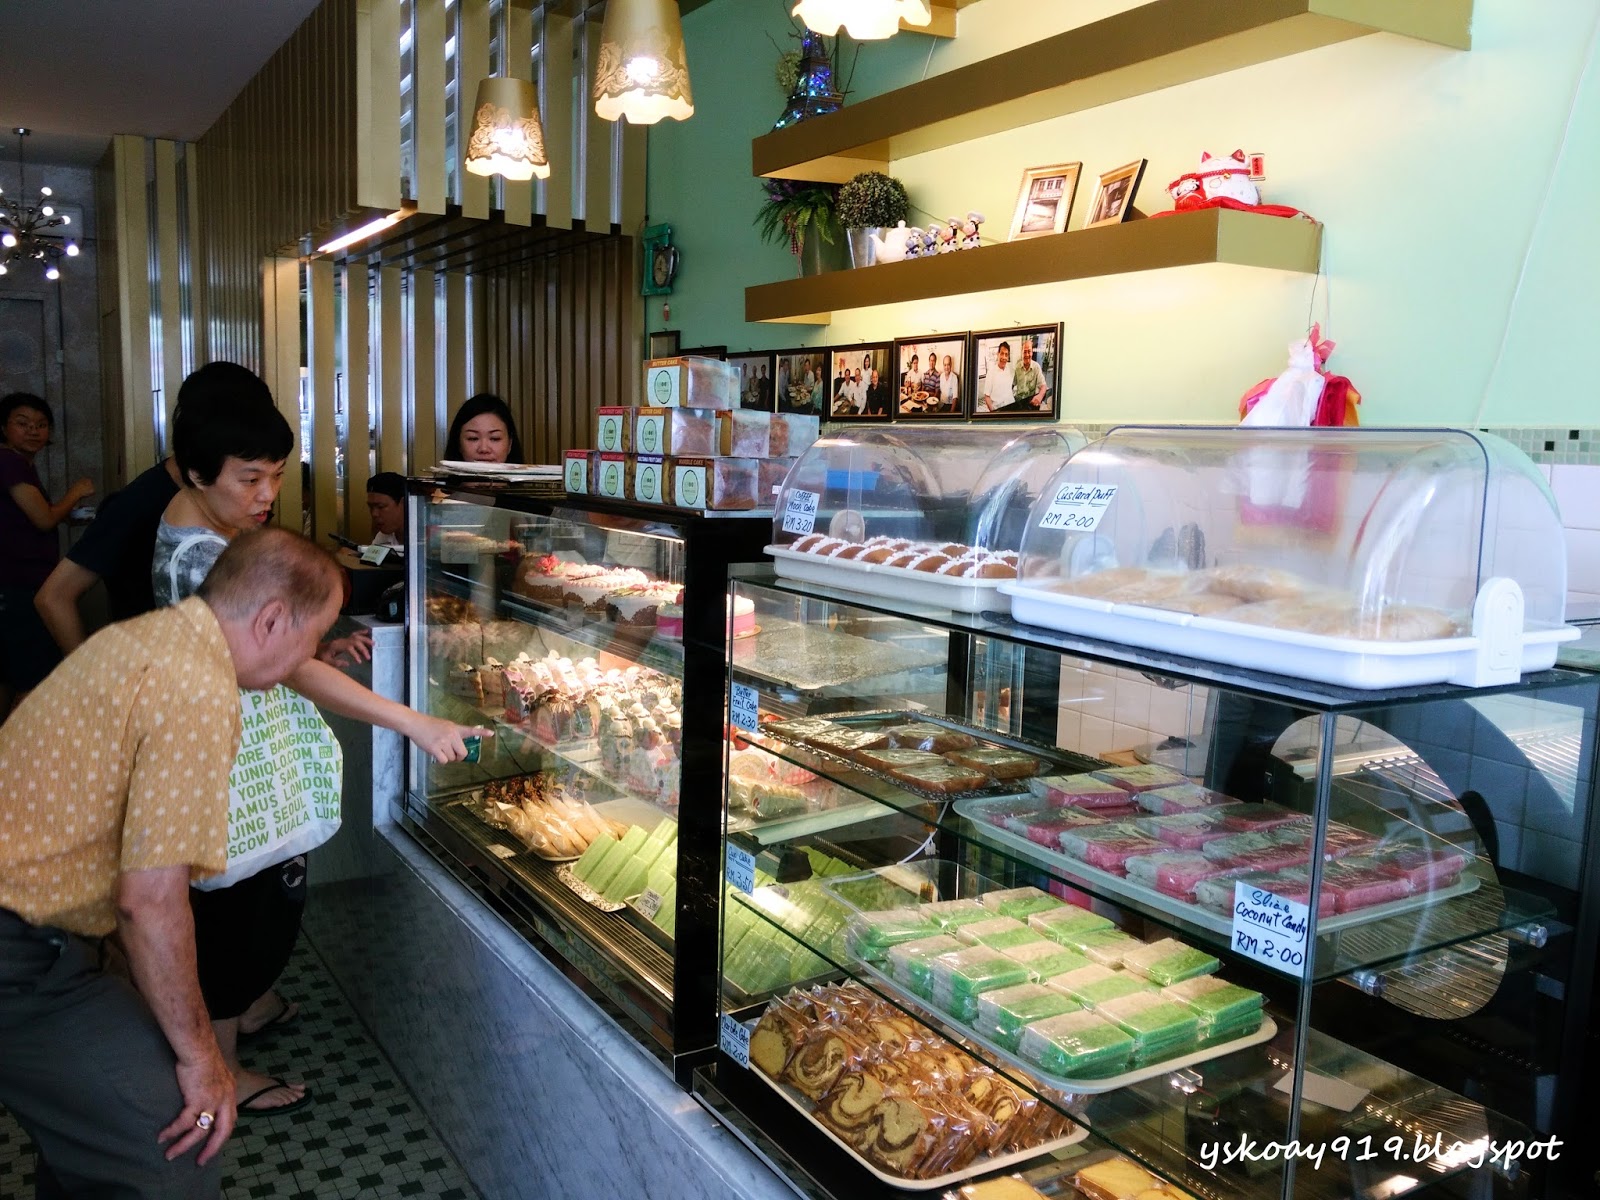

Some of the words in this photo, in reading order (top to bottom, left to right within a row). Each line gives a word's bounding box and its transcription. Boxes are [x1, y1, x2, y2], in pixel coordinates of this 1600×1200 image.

[1056, 485, 1096, 501] Custard
[785, 515, 796, 531] RM
[1042, 512, 1062, 526] RM
[251, 686, 299, 710] PARIS
[241, 702, 306, 731] HANGHAI
[732, 710, 741, 725] RM
[241, 718, 291, 749] LUMPUR
[269, 732, 323, 755] BANGKOK
[238, 777, 276, 801] YORK
[280, 765, 299, 786] SAN
[283, 776, 333, 802] LONDON
[273, 796, 307, 824] SEOUL
[227, 831, 270, 859] SCOW
[276, 811, 311, 839] KUALA
[726, 866, 735, 883] RM
[1235, 901, 1282, 928] Coconut
[1281, 914, 1307, 943] Candy
[1236, 930, 1258, 955] RM
